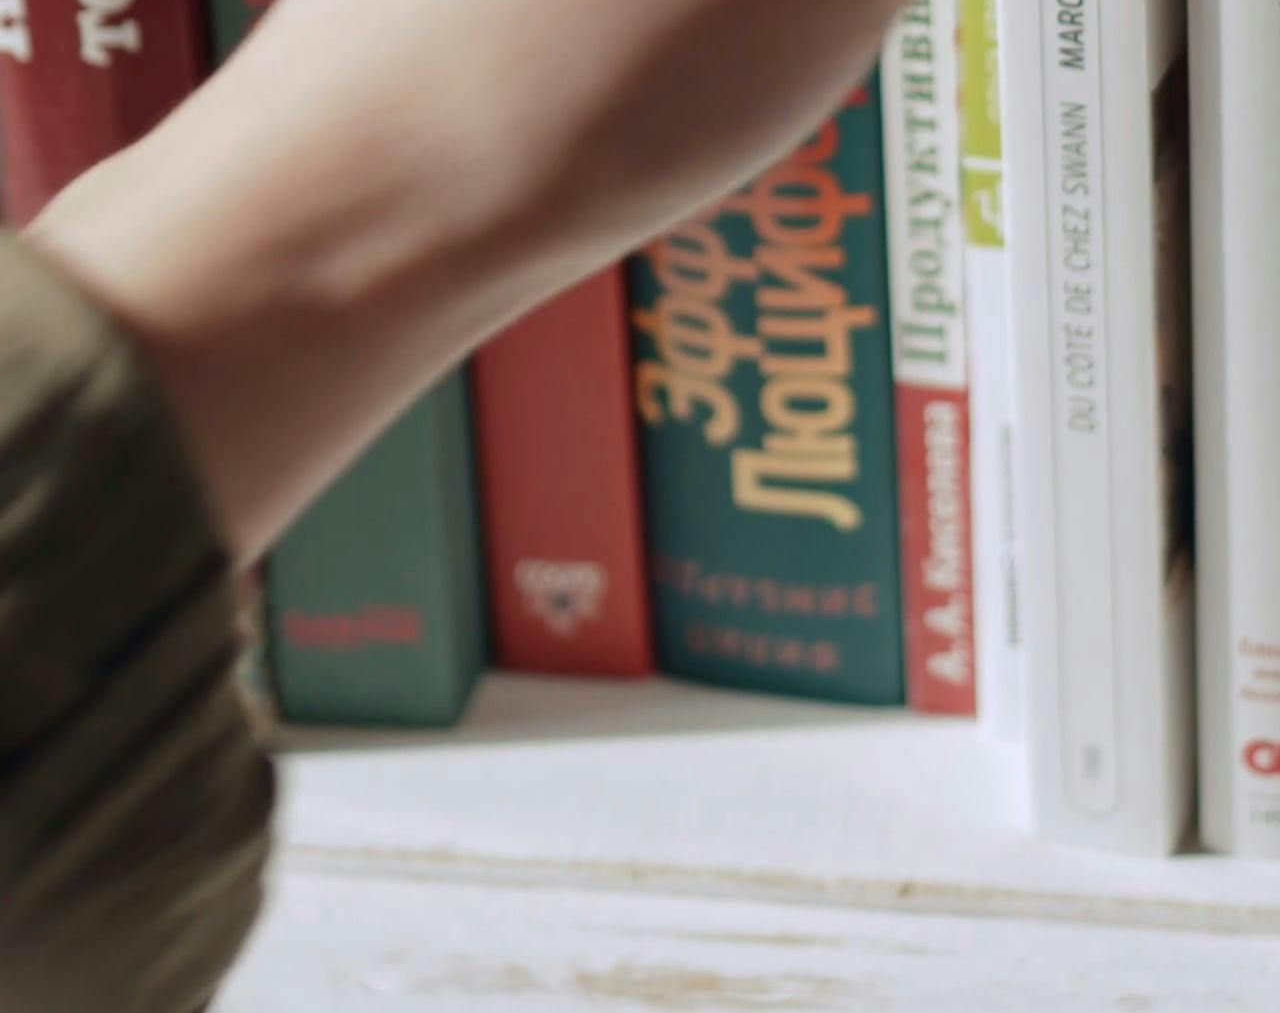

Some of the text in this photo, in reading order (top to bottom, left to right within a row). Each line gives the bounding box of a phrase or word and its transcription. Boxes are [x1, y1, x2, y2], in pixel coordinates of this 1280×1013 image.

[1060, 101, 1090, 196] SWANN
[1062, 204, 1091, 273] CHEZ
[634, 210, 760, 445] Эфф
[1063, 281, 1093, 316] DE
